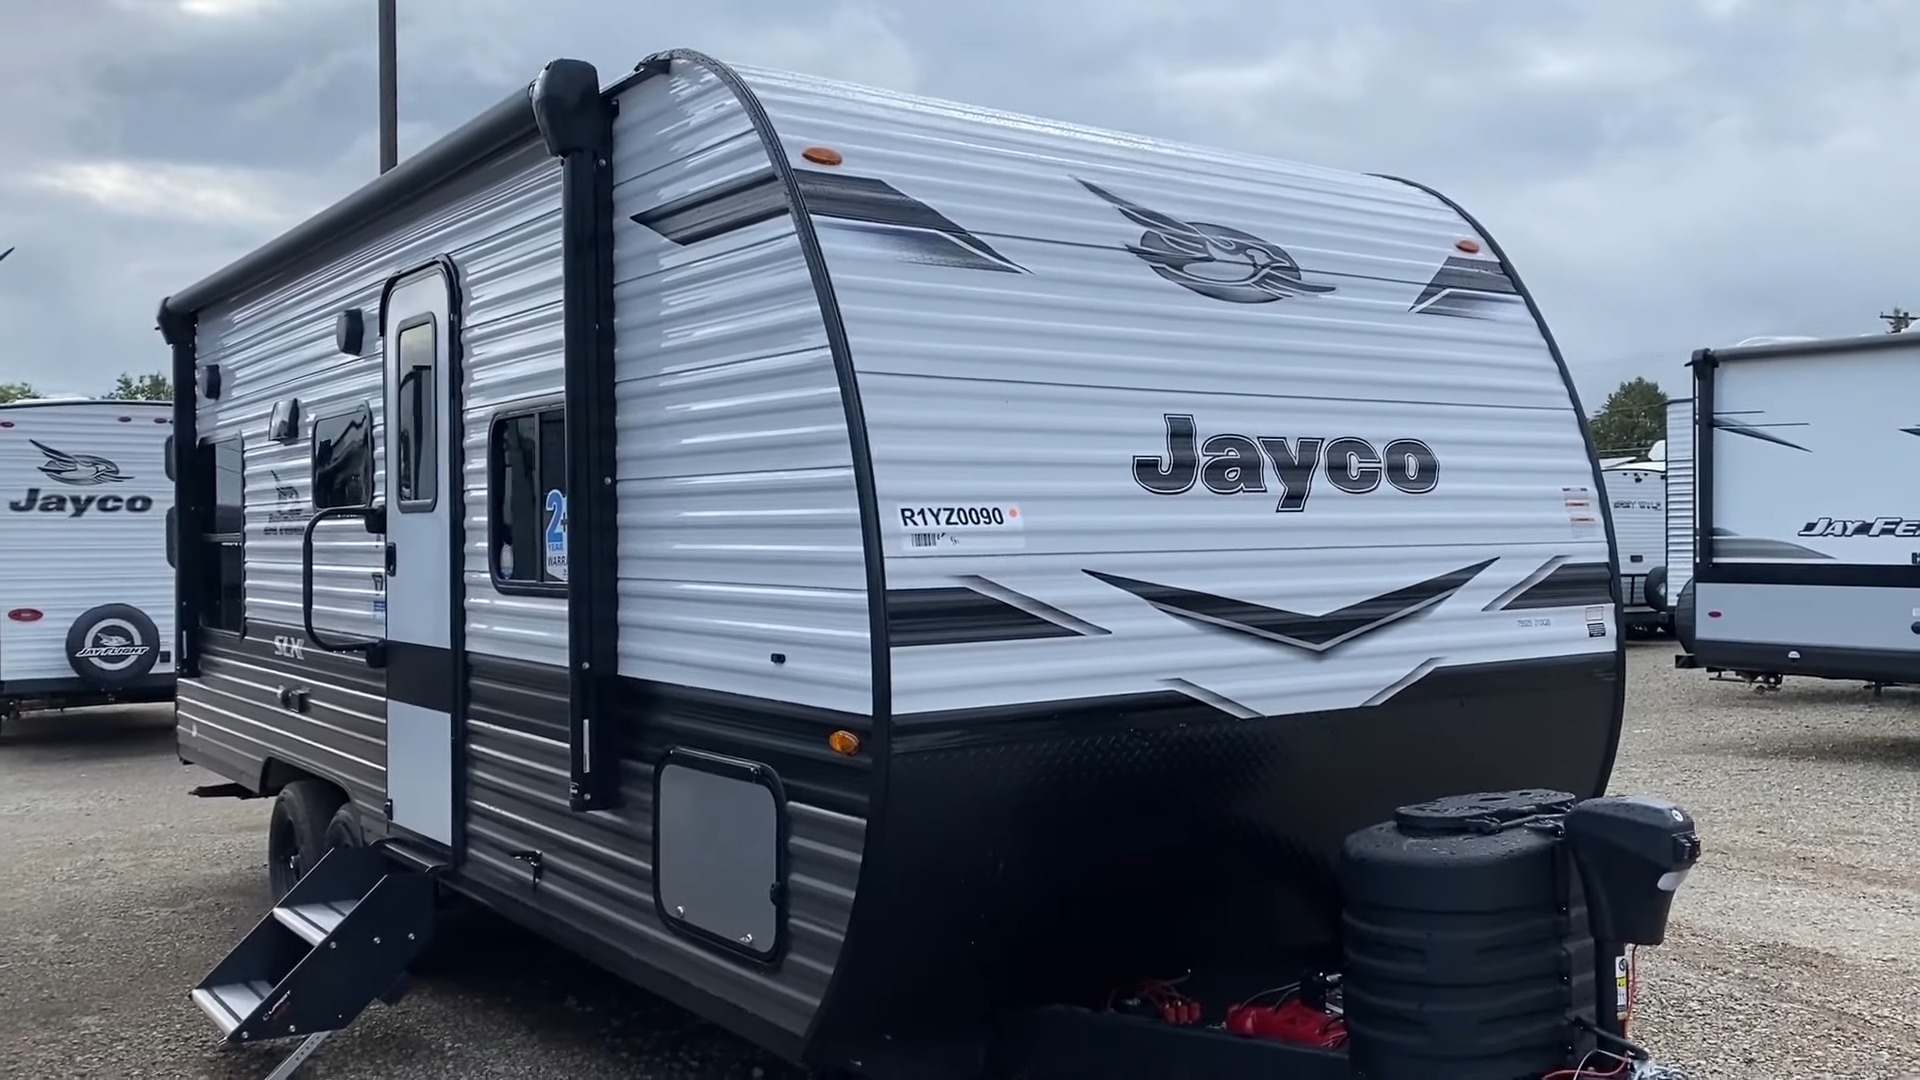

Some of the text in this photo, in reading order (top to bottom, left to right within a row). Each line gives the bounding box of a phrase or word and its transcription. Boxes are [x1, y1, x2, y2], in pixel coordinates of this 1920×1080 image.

[1132, 413, 1439, 512] Jayco
[9, 488, 153, 518] Jayco
[900, 507, 1004, 526] R1YZ0090
[1798, 516, 1920, 537] JAY FE
[75, 646, 150, 657] JAY FLIGHT
